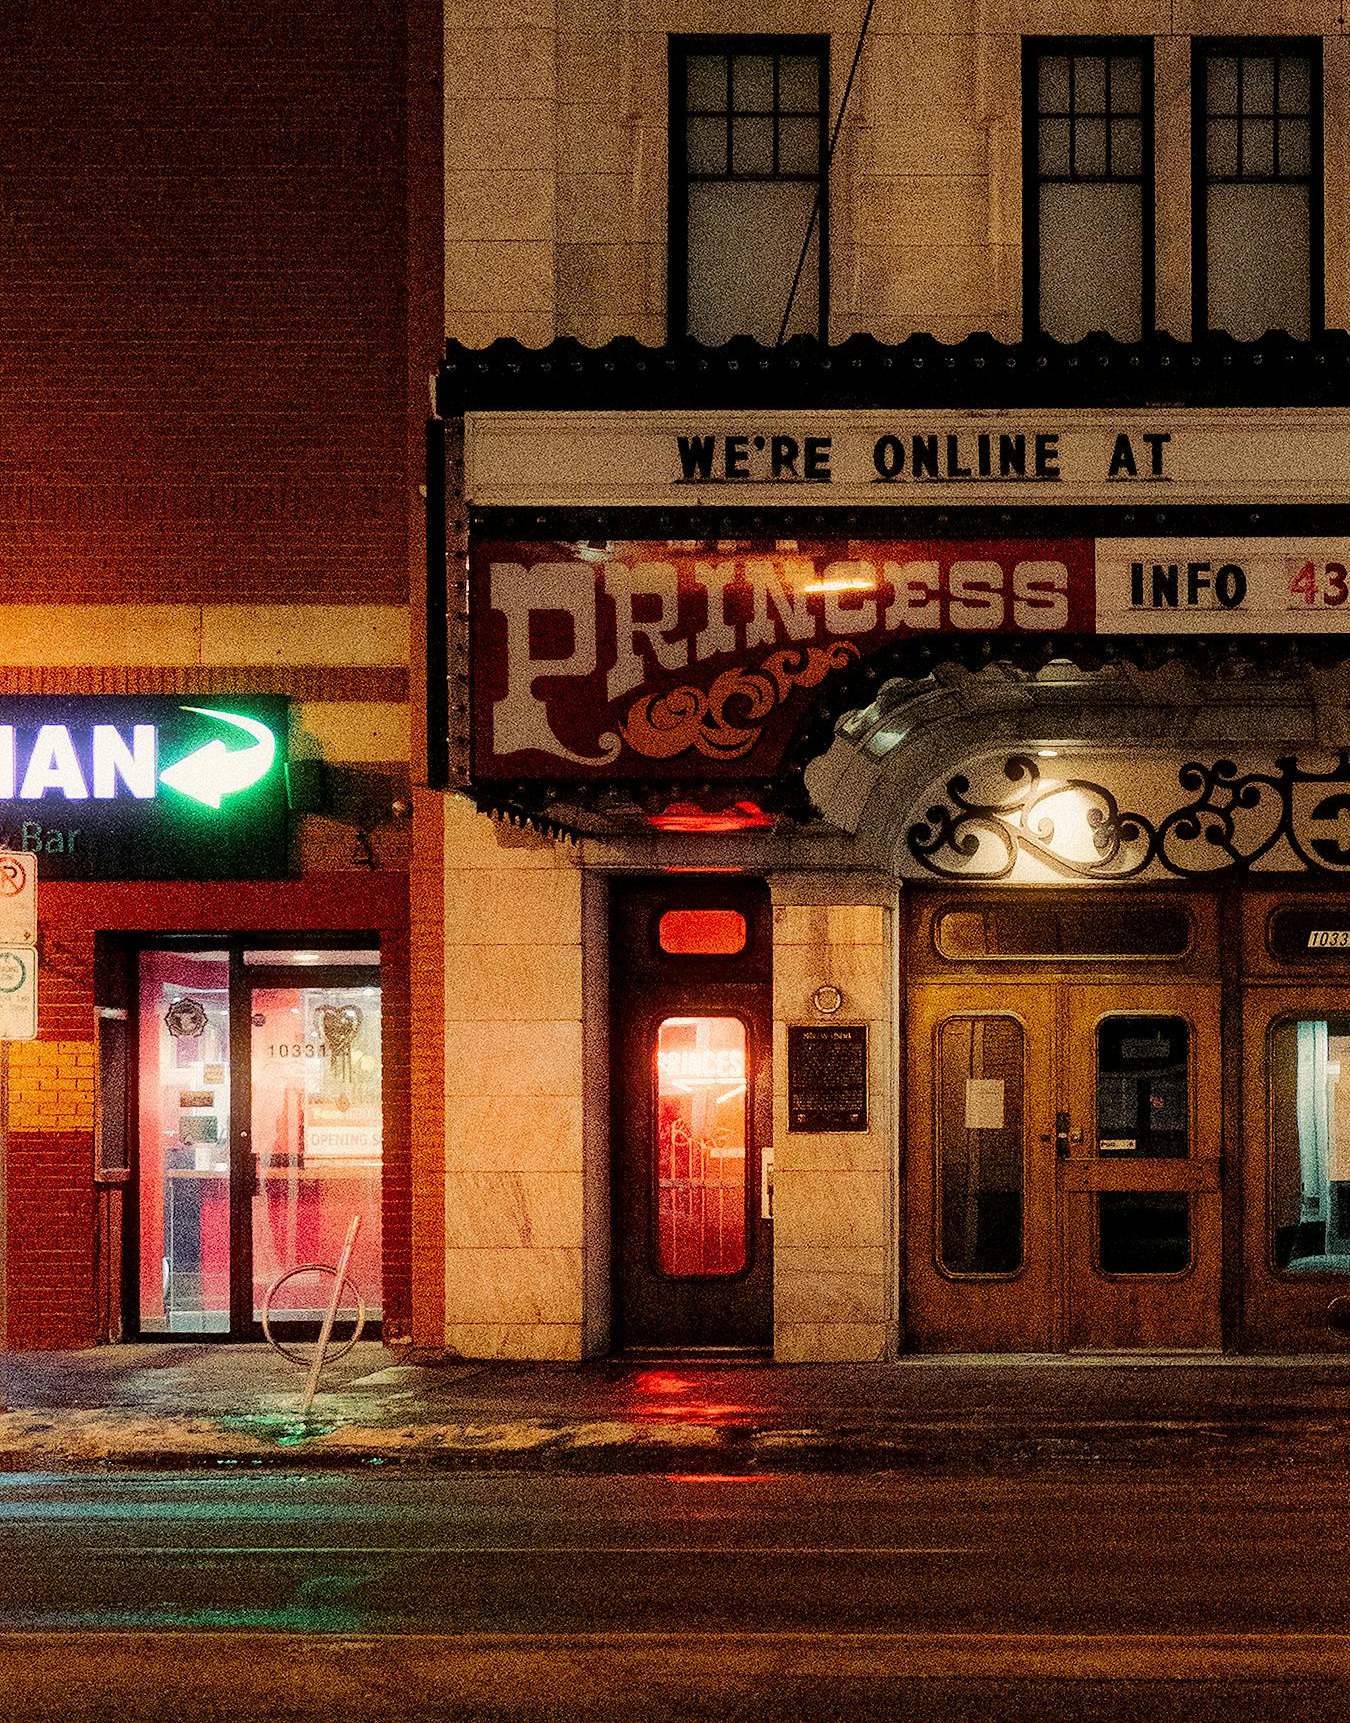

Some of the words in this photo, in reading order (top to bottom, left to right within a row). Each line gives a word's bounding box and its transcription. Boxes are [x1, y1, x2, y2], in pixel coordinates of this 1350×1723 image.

[677, 435, 832, 478] WE'RE
[873, 434, 1061, 477] ONLINE
[1107, 434, 1171, 476] AT
[1130, 562, 1247, 609] INFO
[489, 559, 1069, 767] PRINCESS
[22, 821, 80, 854] Bar
